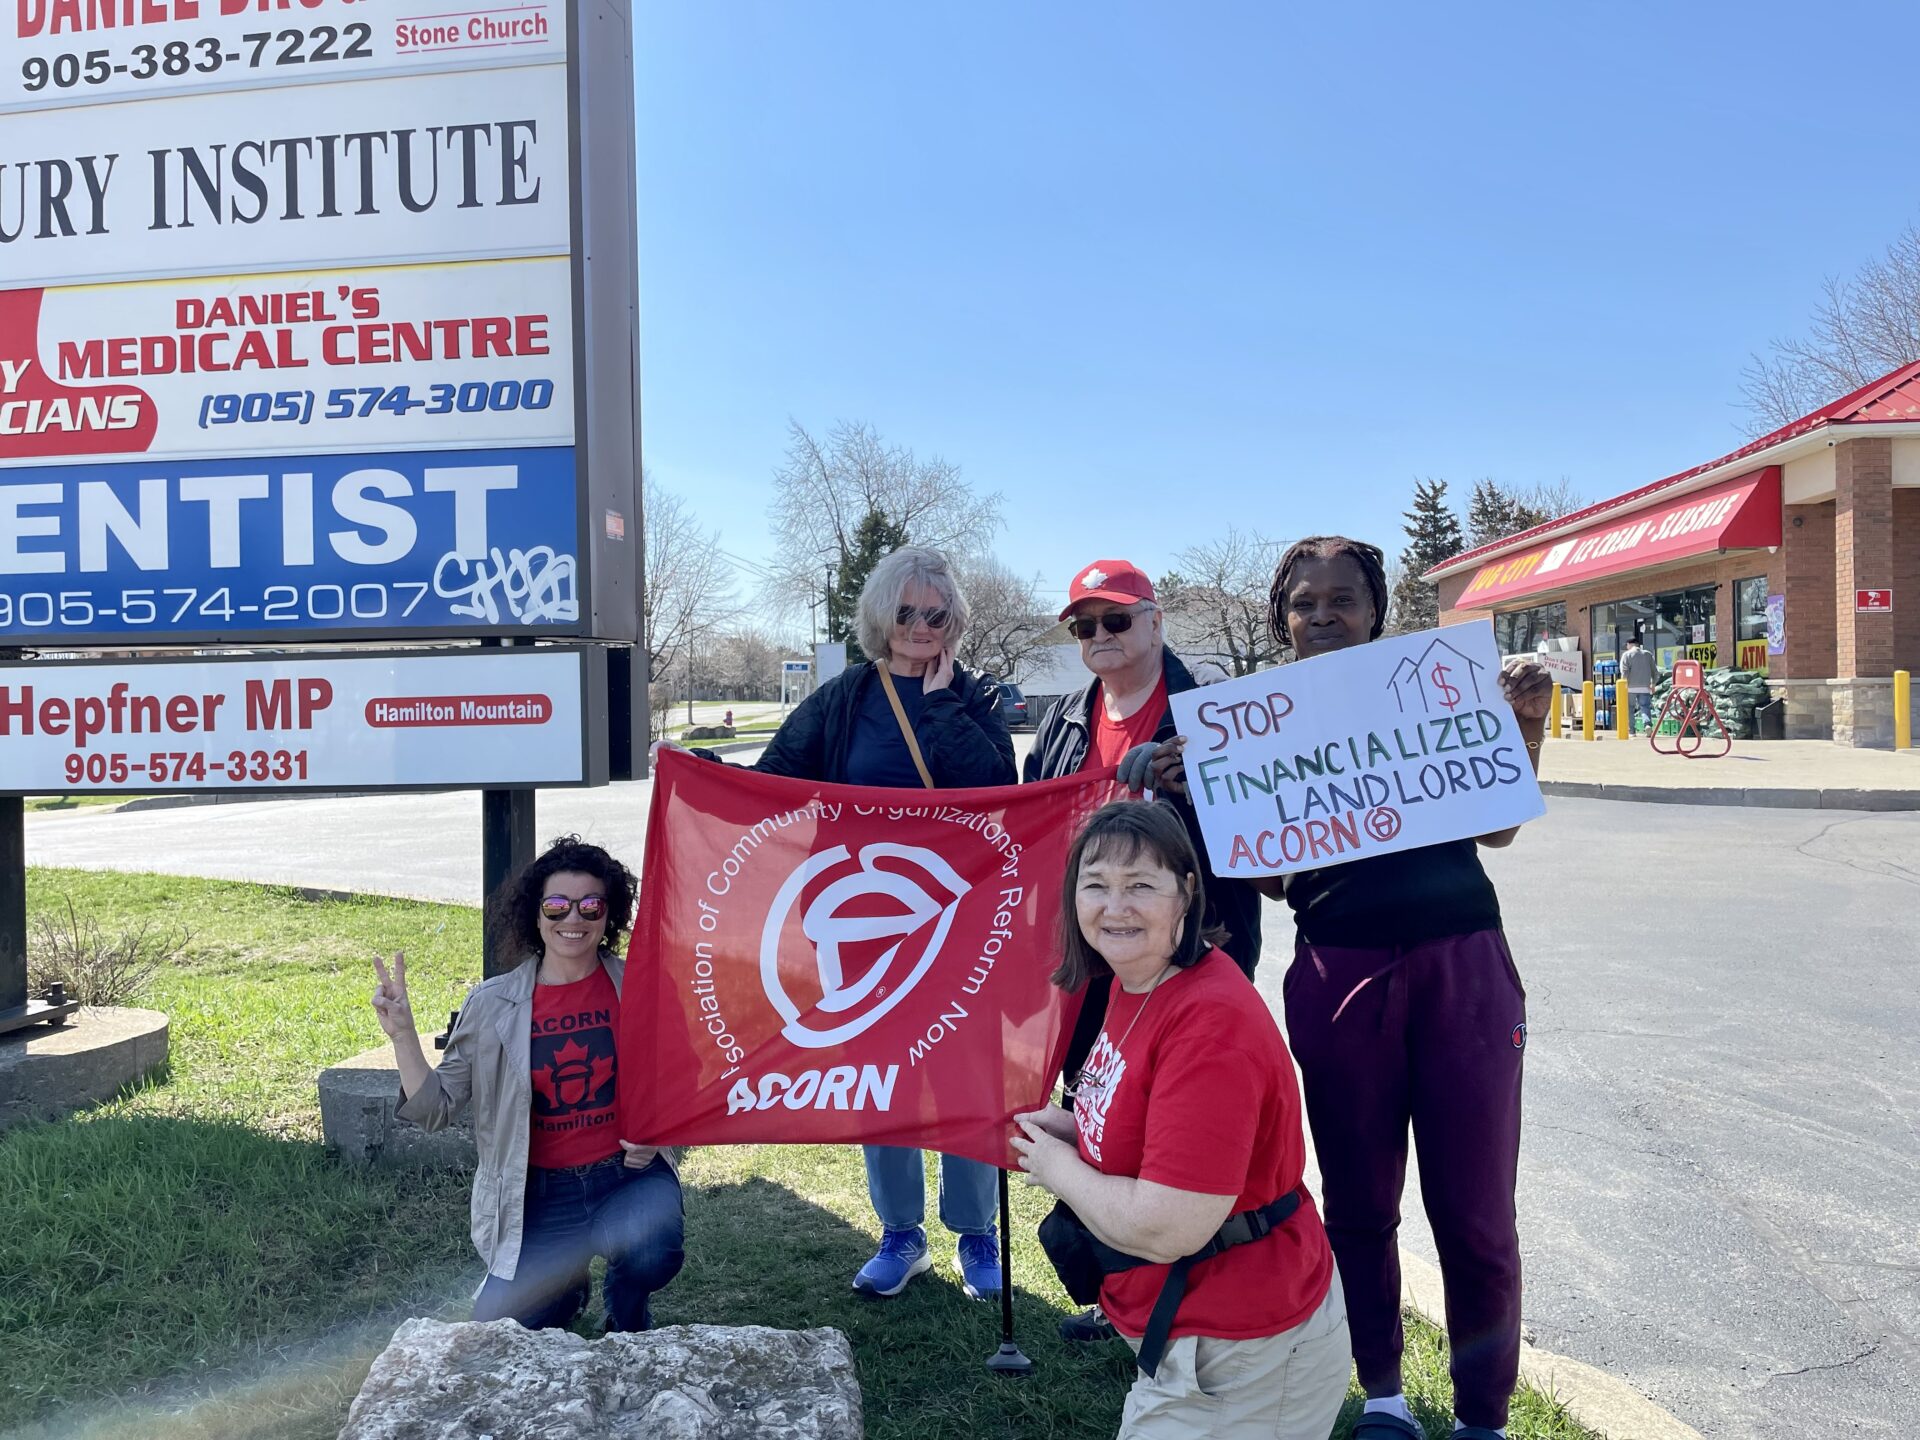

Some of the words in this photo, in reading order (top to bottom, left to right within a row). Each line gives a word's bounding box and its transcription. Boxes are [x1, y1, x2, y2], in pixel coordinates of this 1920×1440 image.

[22, 22, 373, 92] 905-383-7222
[395, 21, 459, 48] Stone
[466, 12, 548, 41] Church
[148, 119, 541, 231] INSTITUTE
[176, 285, 380, 330] DANIEL'S
[58, 328, 308, 381] MEDICAL
[321, 314, 550, 368] CENTRE
[199, 390, 315, 429] (905)
[325, 378, 553, 420] 574-3000
[1689, 647, 1709, 661] KEYS
[1742, 645, 1766, 670] ATM
[0, 680, 224, 748] Hepfner
[246, 677, 333, 731] MP
[375, 701, 455, 722] Hamilton
[460, 699, 543, 721] Mountain
[1197, 692, 1294, 752] STOP
[65, 750, 309, 784] 905-574-3331
[1198, 709, 1502, 806] FINANCIALIZED
[1275, 747, 1522, 825] LANDLORDS
[706, 800, 842, 896] Community
[1228, 811, 1361, 869] ACORN
[698, 898, 720, 932] of
[961, 886, 1023, 995] Reform
[532, 1009, 611, 1034] ACORN
[908, 1000, 969, 1067] Now
[726, 1064, 900, 1116] ACORN
[536, 1111, 616, 1133] Hamilton
